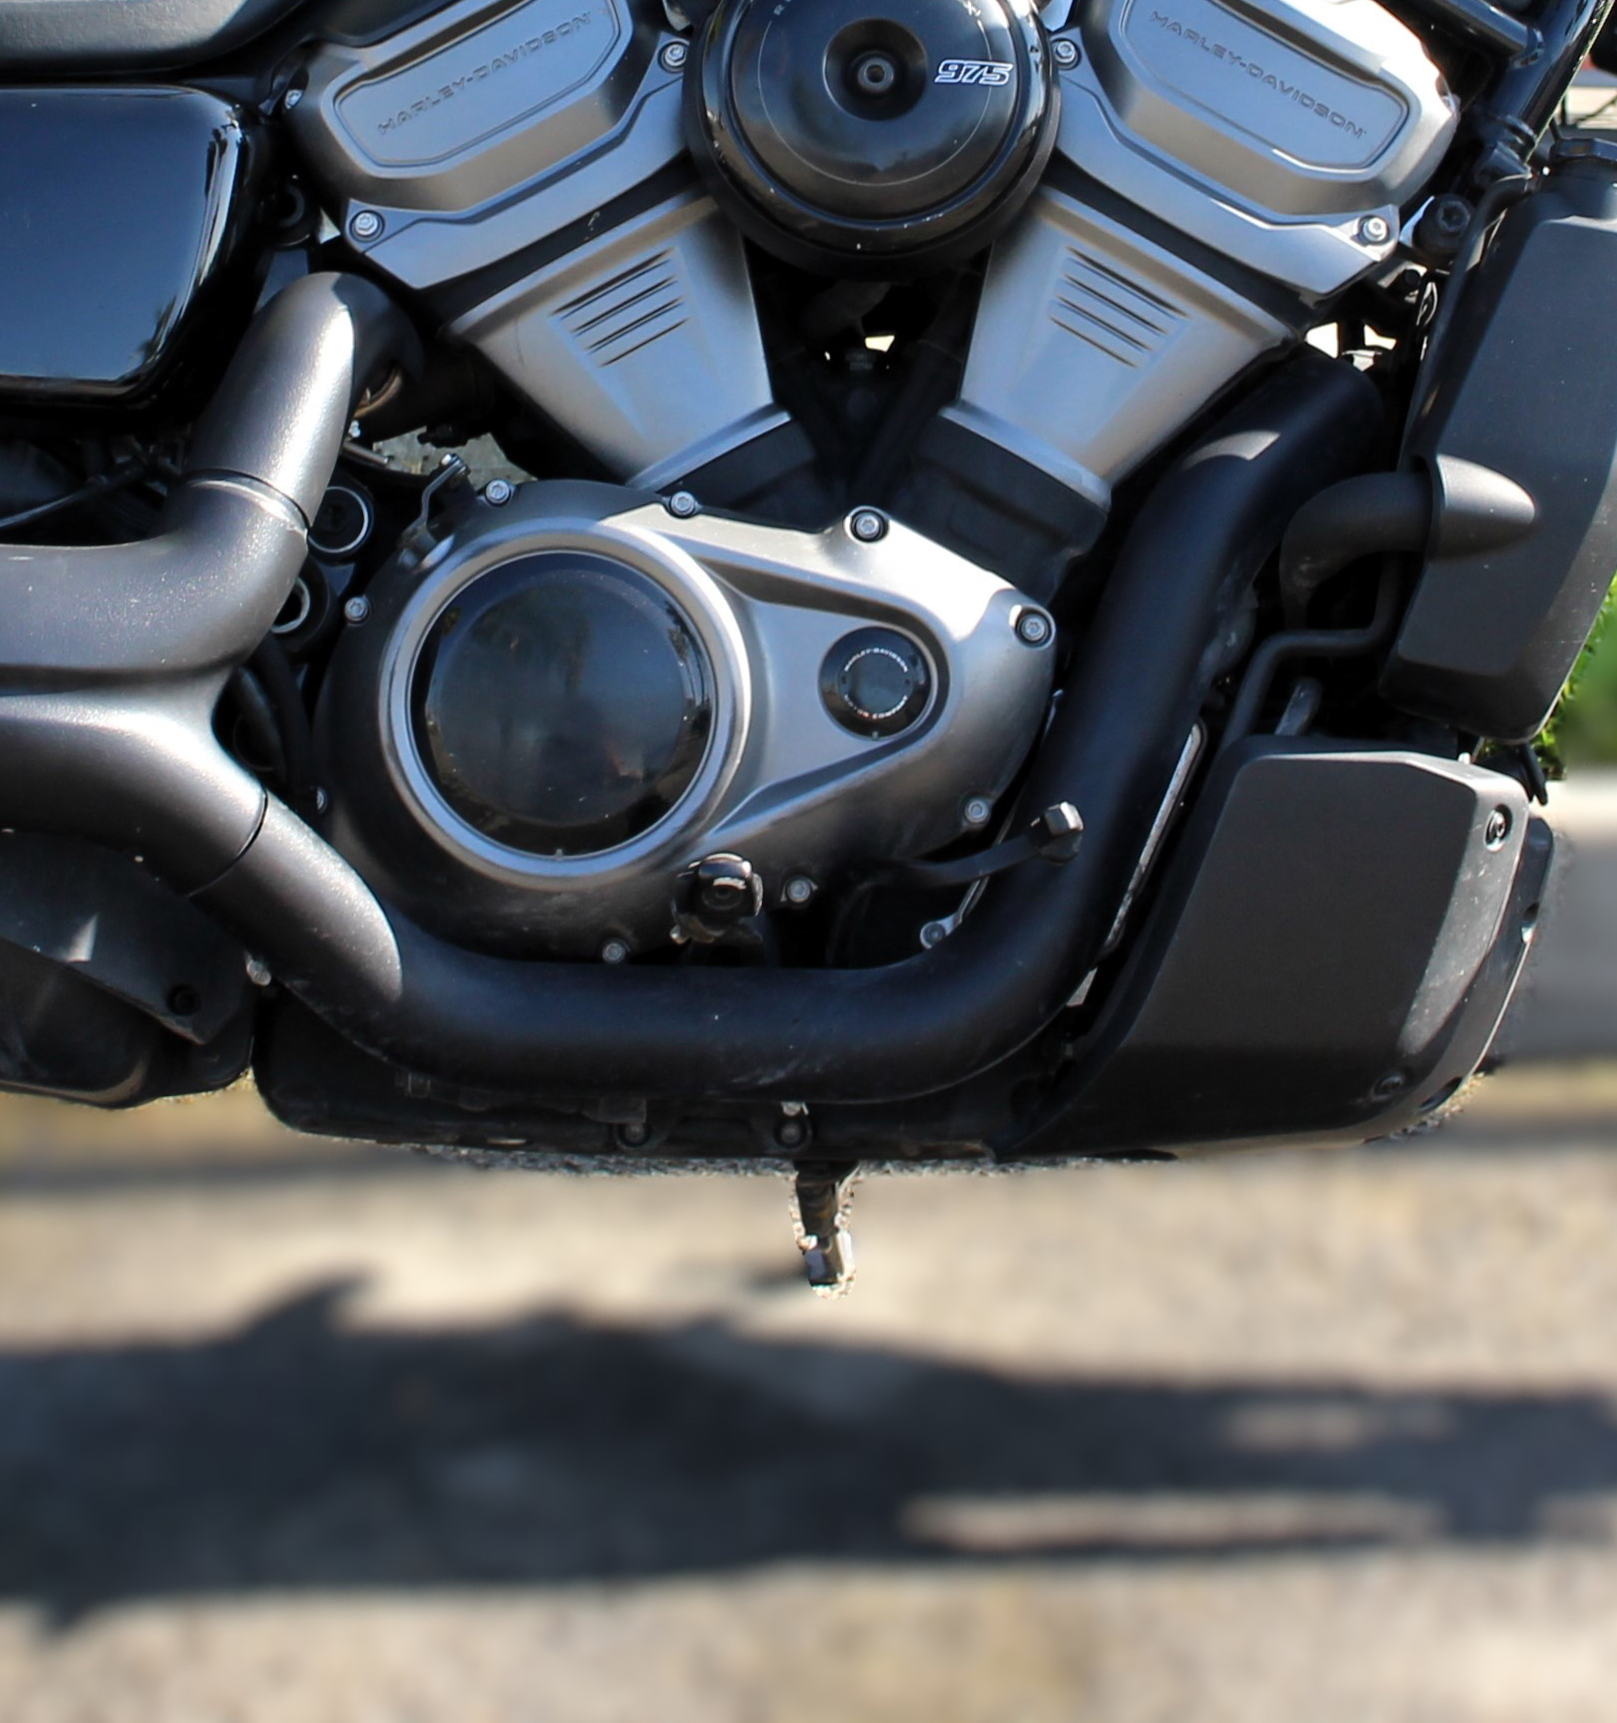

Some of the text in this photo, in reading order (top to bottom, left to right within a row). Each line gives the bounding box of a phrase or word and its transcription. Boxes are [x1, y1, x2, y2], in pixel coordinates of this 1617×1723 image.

[376, 9, 593, 136] HARLEY-DAVIDSON
[934, 58, 1015, 87] 975
[1149, 9, 1367, 140] HARLEY-DAVIDSON
